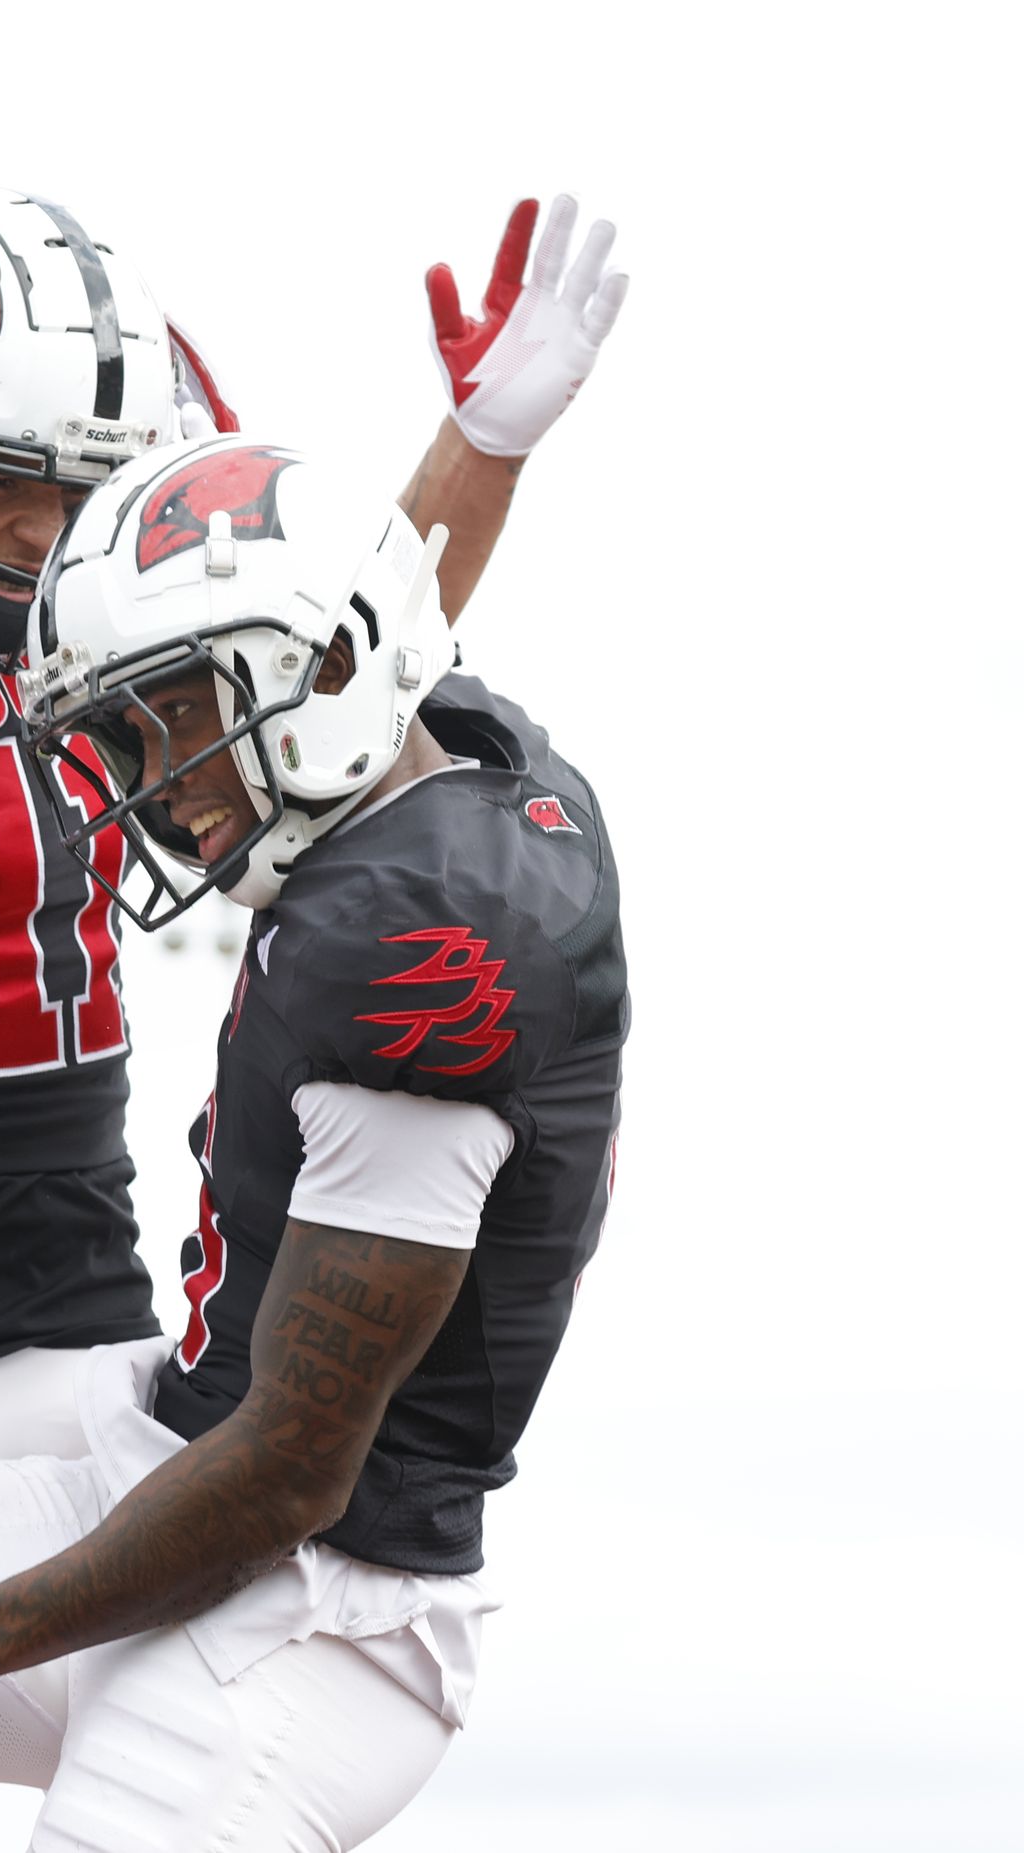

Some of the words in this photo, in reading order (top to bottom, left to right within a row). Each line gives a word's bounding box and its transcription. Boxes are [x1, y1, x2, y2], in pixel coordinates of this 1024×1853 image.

[85, 428, 128, 443] schutt
[307, 1259, 401, 1330] WILL
[274, 1301, 385, 1383] FEAR
